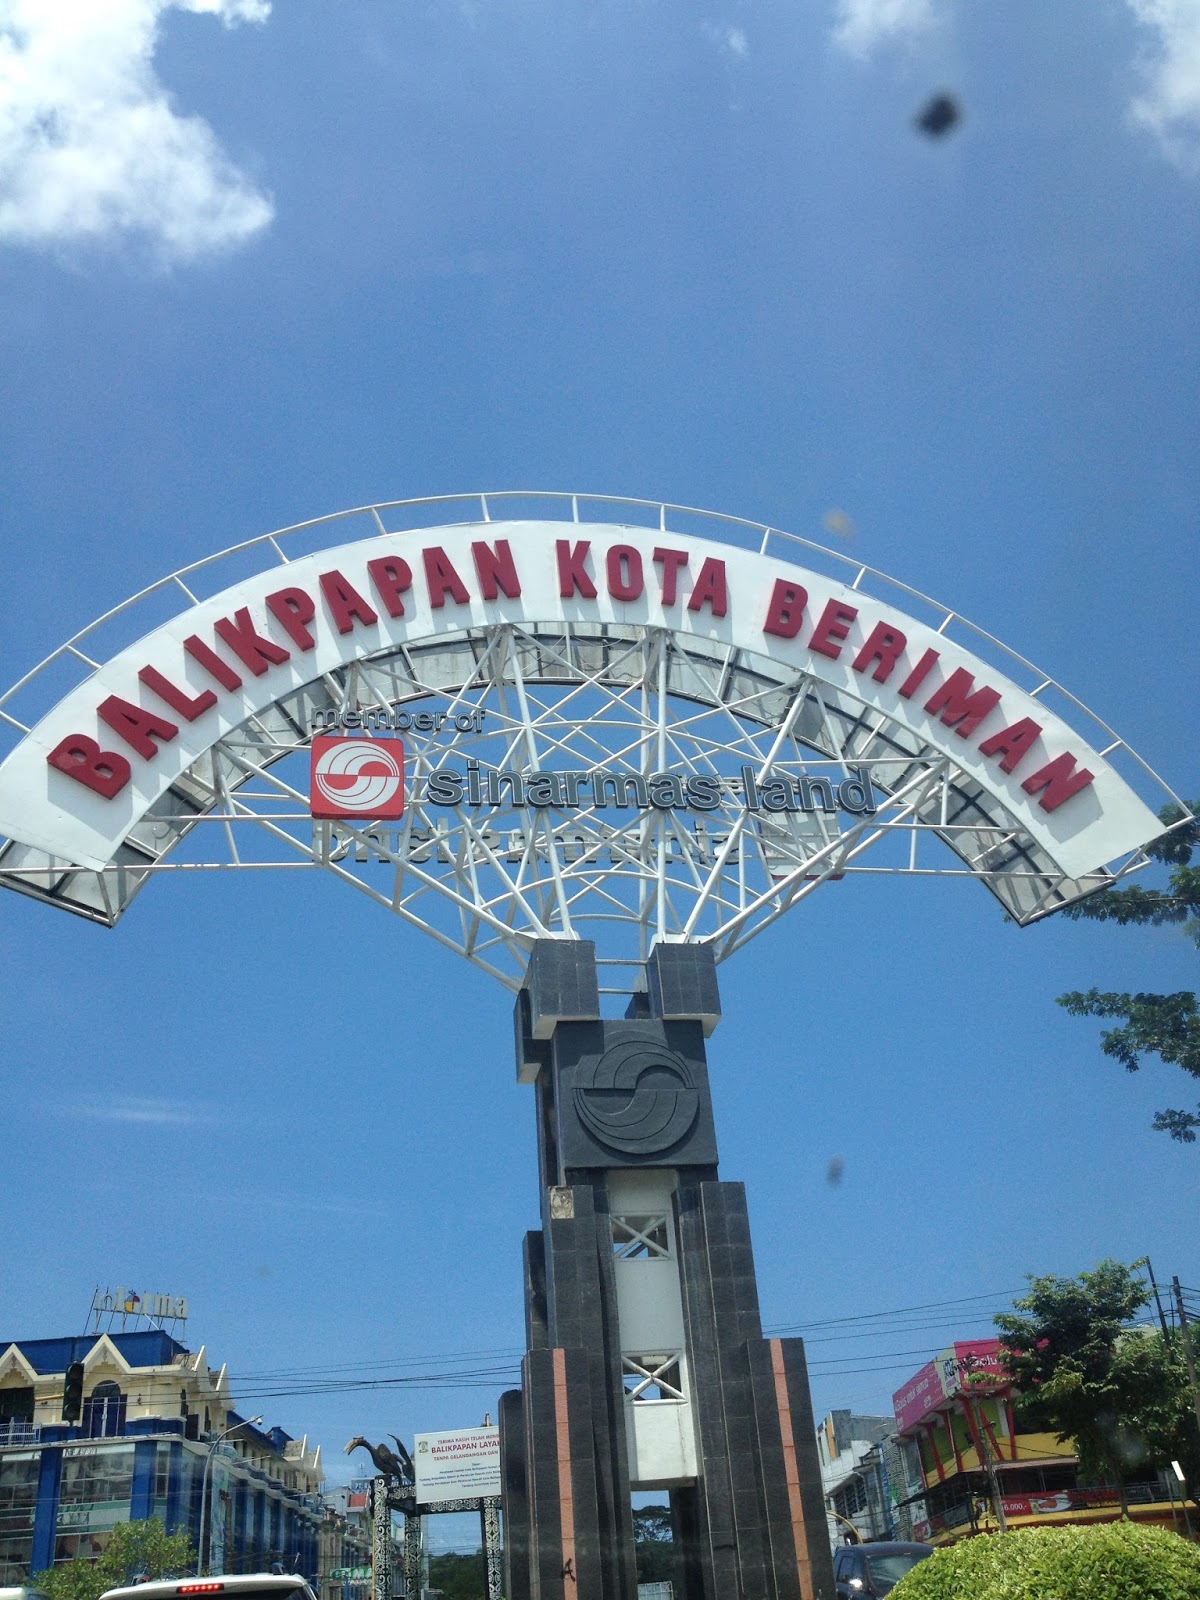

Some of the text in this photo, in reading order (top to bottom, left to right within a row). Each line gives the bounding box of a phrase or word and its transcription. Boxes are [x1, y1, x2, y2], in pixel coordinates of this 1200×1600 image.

[46, 539, 1096, 815] BALIKPAPAN KOTA BERIMAN
[311, 705, 486, 733] member of
[427, 758, 878, 815] sinarmas land
[431, 1442, 477, 1454] BALIKPAPAN
[450, 1452, 487, 1460] GELANDANGAN
